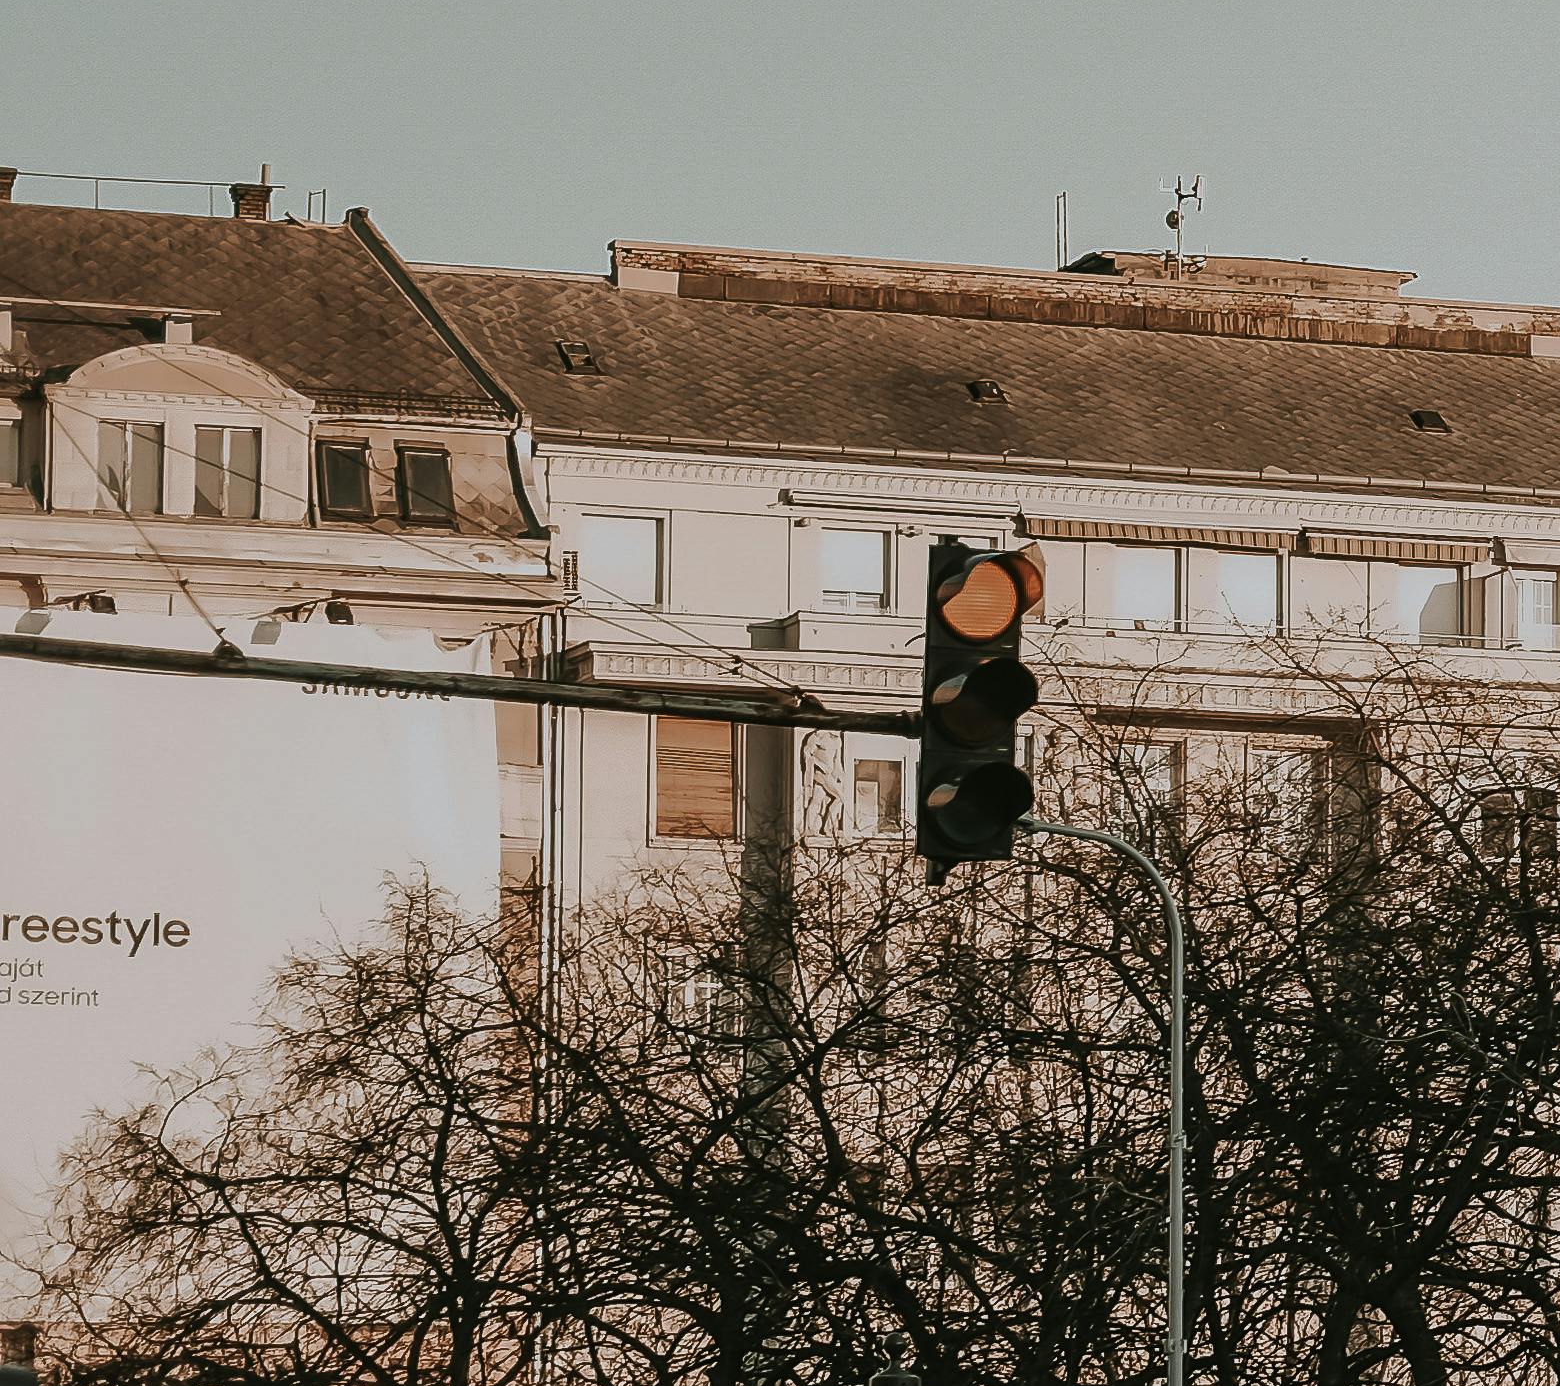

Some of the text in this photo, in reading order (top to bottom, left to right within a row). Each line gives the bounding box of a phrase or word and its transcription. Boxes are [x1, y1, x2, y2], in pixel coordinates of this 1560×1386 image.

[0, 910, 192, 958] reestyle
[0, 957, 44, 982] aját
[17, 986, 100, 1006] szerint
